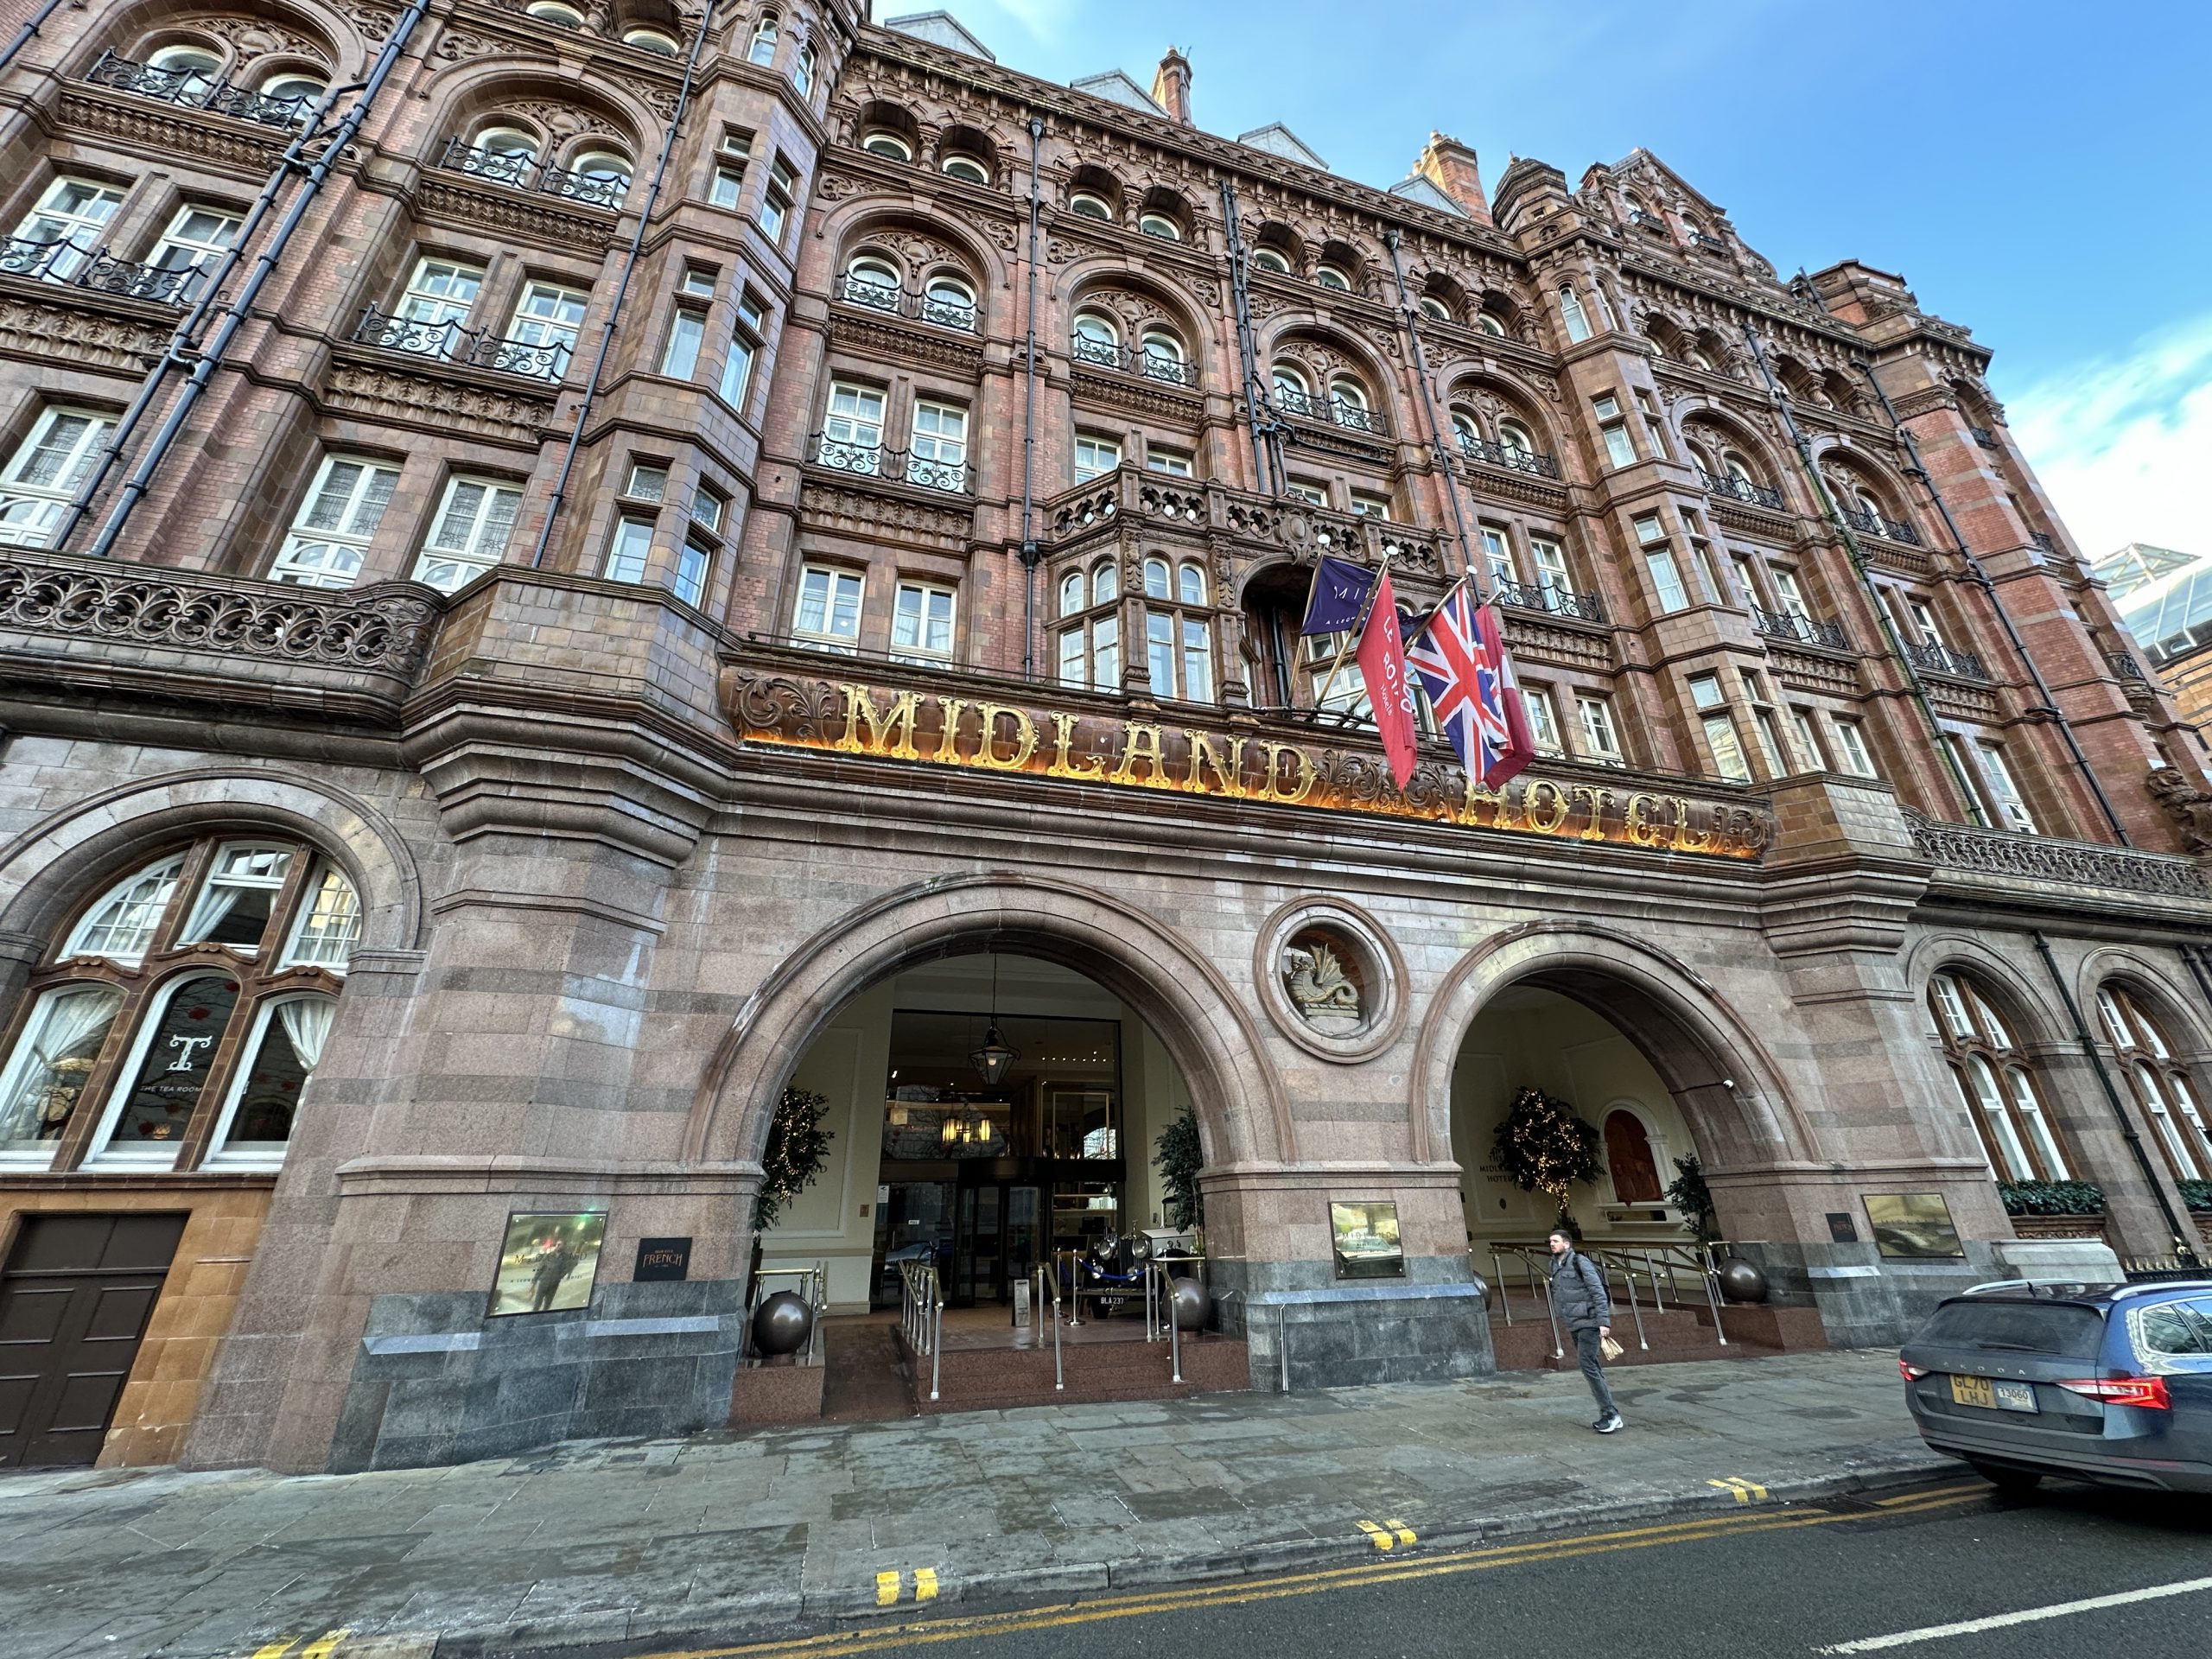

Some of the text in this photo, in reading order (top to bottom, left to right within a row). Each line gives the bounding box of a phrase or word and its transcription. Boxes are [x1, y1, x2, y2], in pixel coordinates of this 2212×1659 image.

[834, 682, 1712, 853] MIDLAND HOTEL
[643, 1253, 683, 1268] FRENCH
[1960, 1390, 1988, 1406] LHJ
